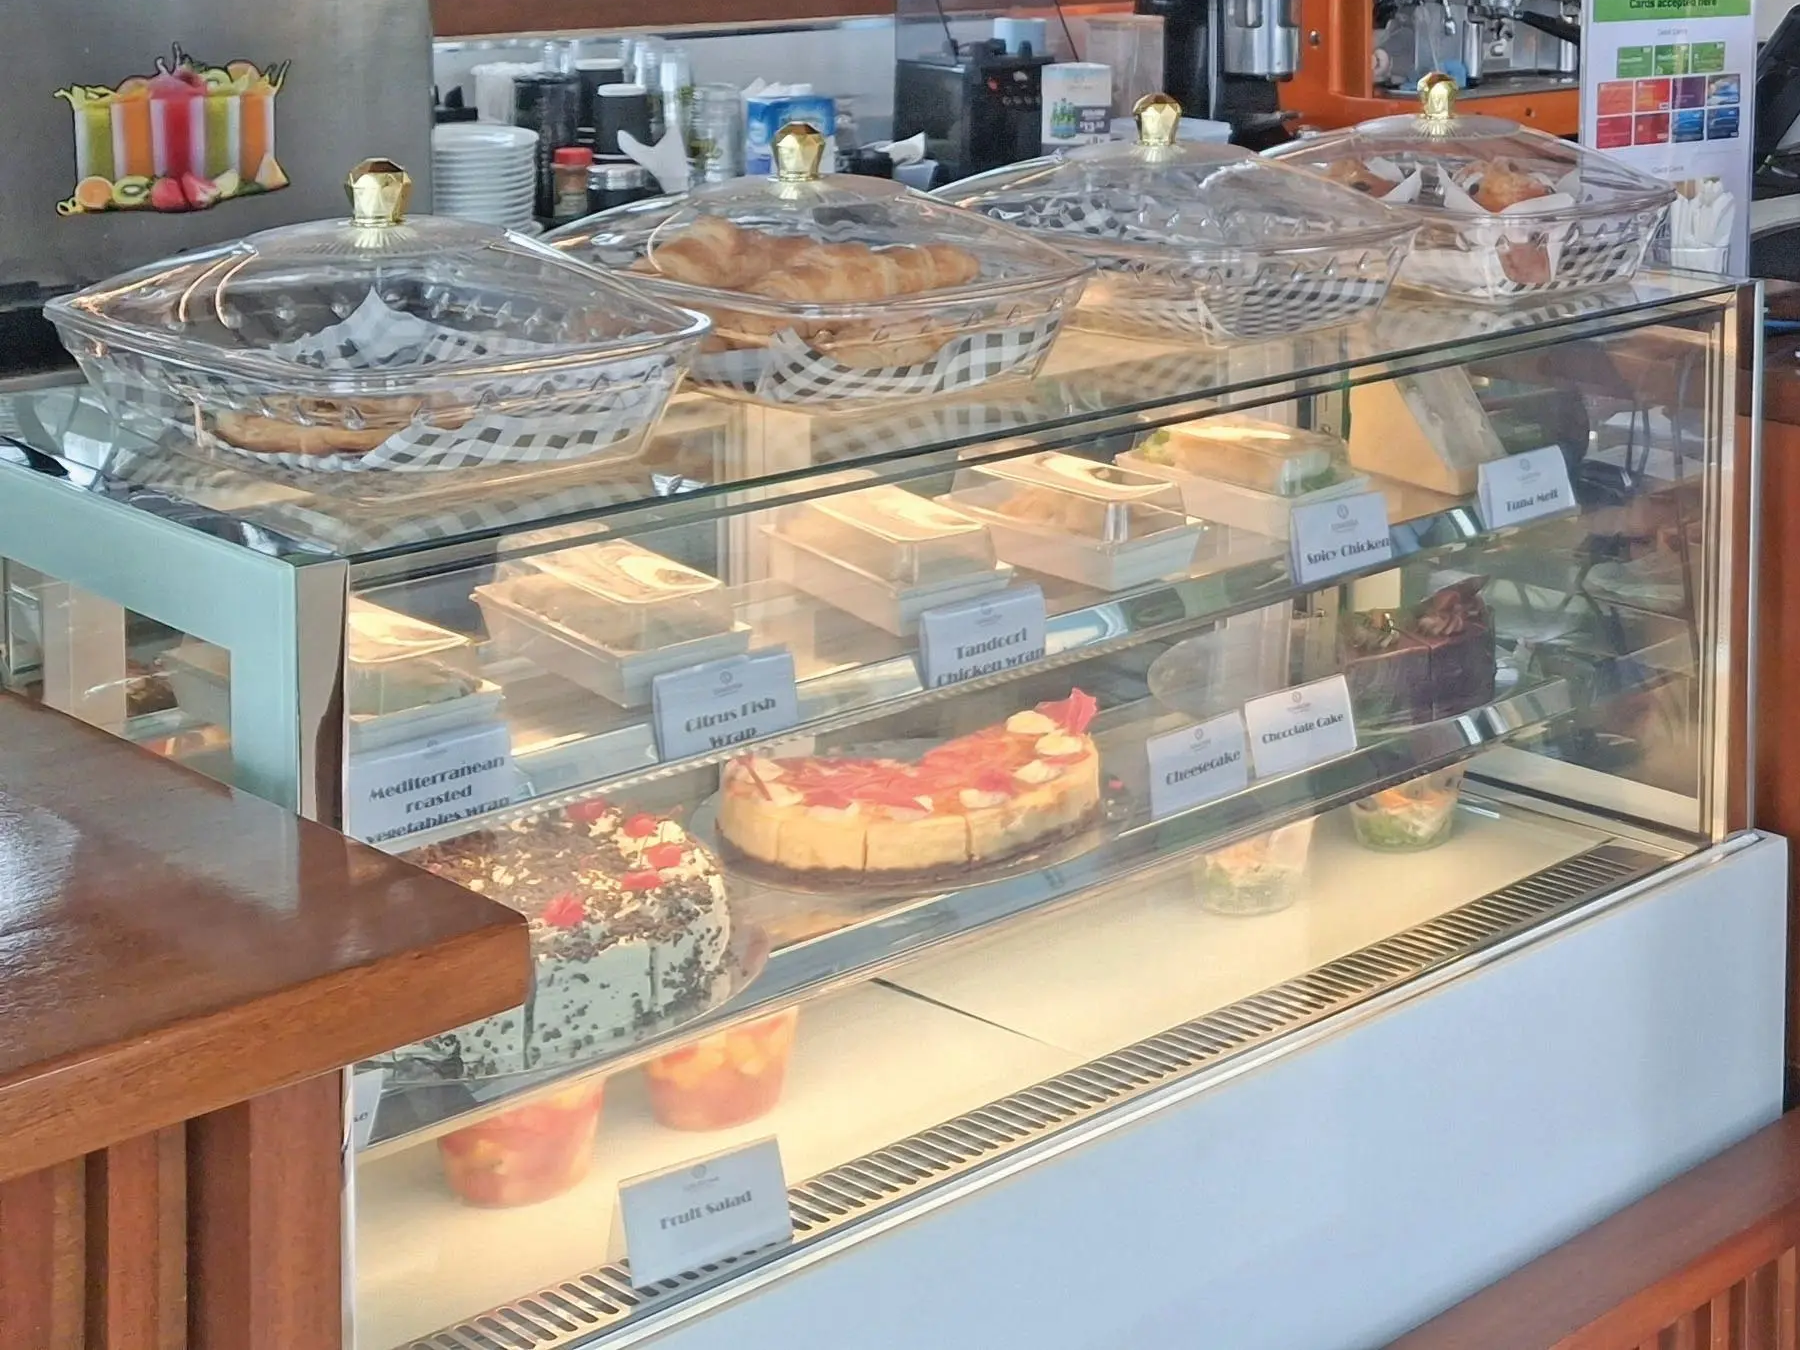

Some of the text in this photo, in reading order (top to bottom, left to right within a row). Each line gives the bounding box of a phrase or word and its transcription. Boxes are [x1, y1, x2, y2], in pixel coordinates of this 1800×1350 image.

[1505, 497, 1534, 512] Tuna
[1306, 537, 1390, 565] Spicy Chicken
[954, 627, 1027, 660] Tandoori
[936, 659, 1003, 688] Chicken
[684, 697, 777, 733] Citrus Fish
[1261, 712, 1344, 745] Chocolate Cake
[368, 756, 505, 803] Mediterranean
[1166, 748, 1241, 786] Cheesecake
[405, 784, 473, 815] roasted
[365, 811, 463, 844] vegetables
[659, 1190, 753, 1231] Fruit Salad
